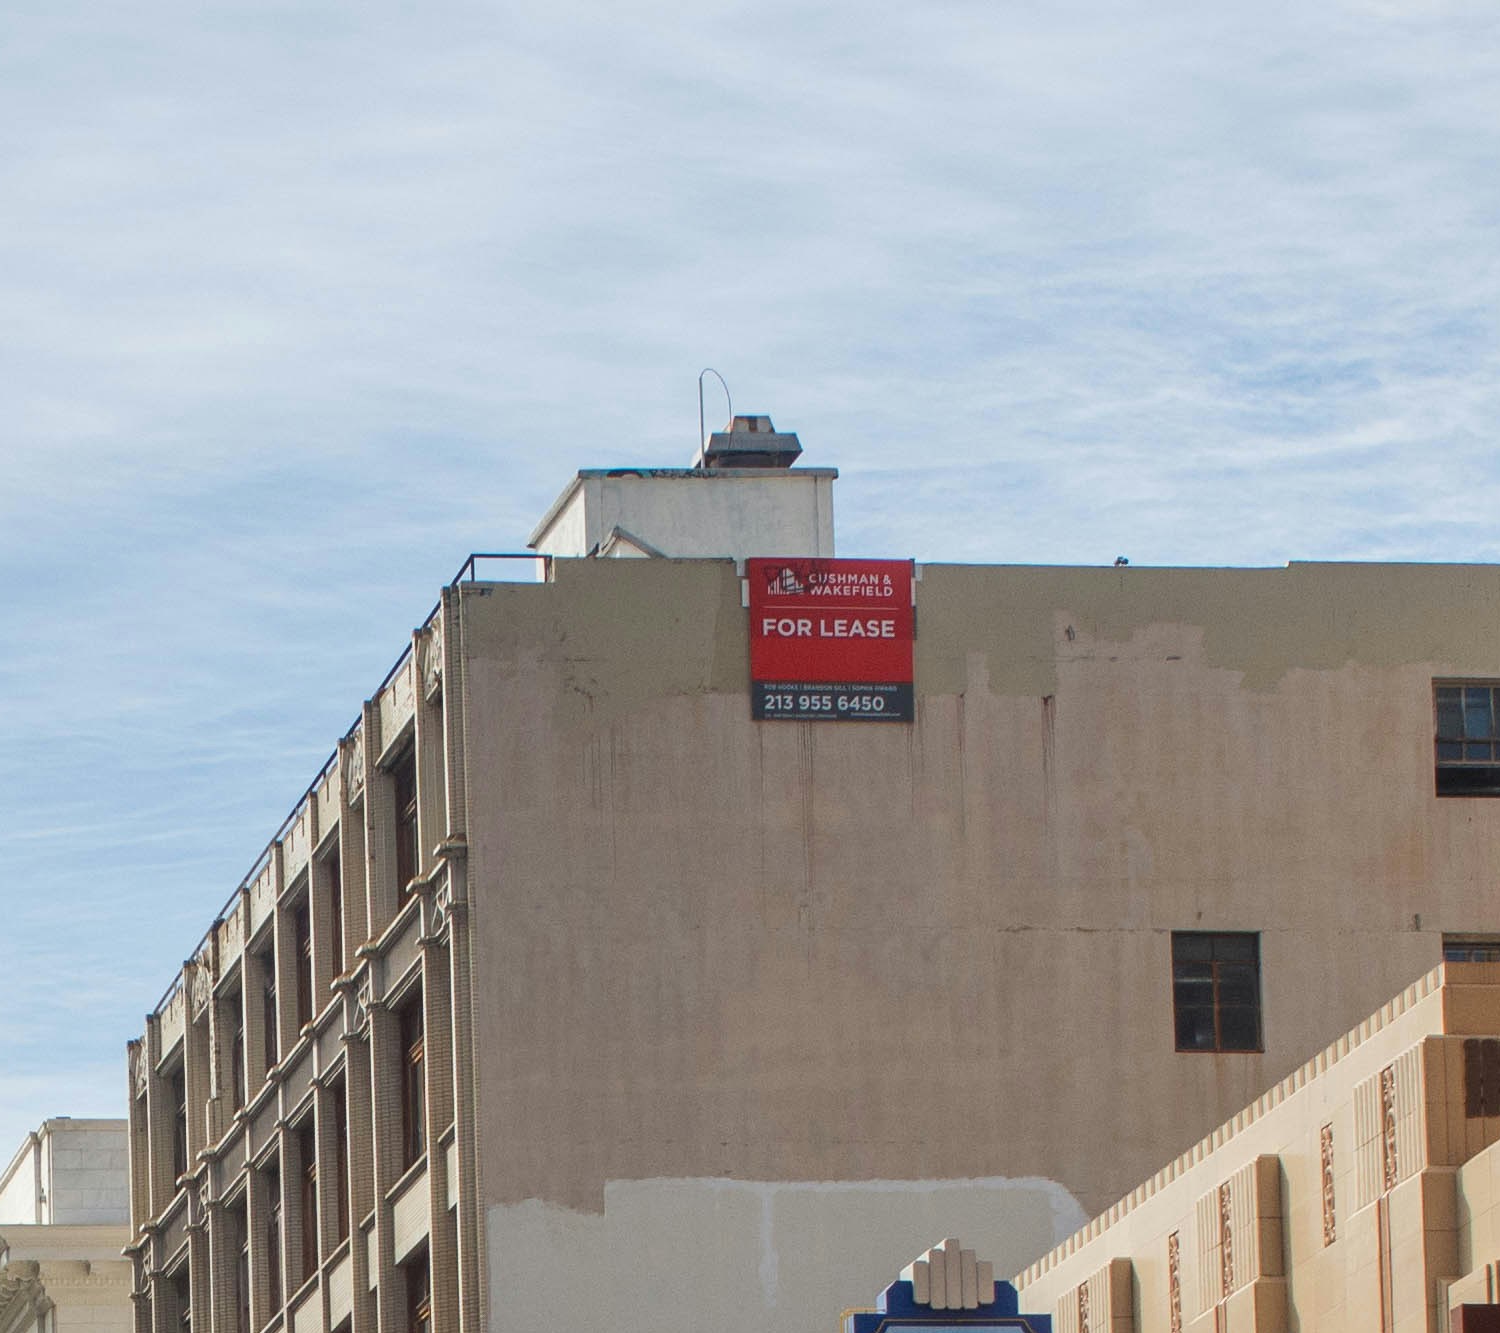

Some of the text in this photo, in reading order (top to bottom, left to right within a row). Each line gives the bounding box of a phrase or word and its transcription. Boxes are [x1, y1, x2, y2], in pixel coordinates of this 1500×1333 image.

[808, 572, 892, 585] CUSHMAN &
[809, 585, 894, 597] WAKEFIELD
[762, 618, 896, 638] FOR LEASE
[764, 695, 885, 711] 213 955 6450
